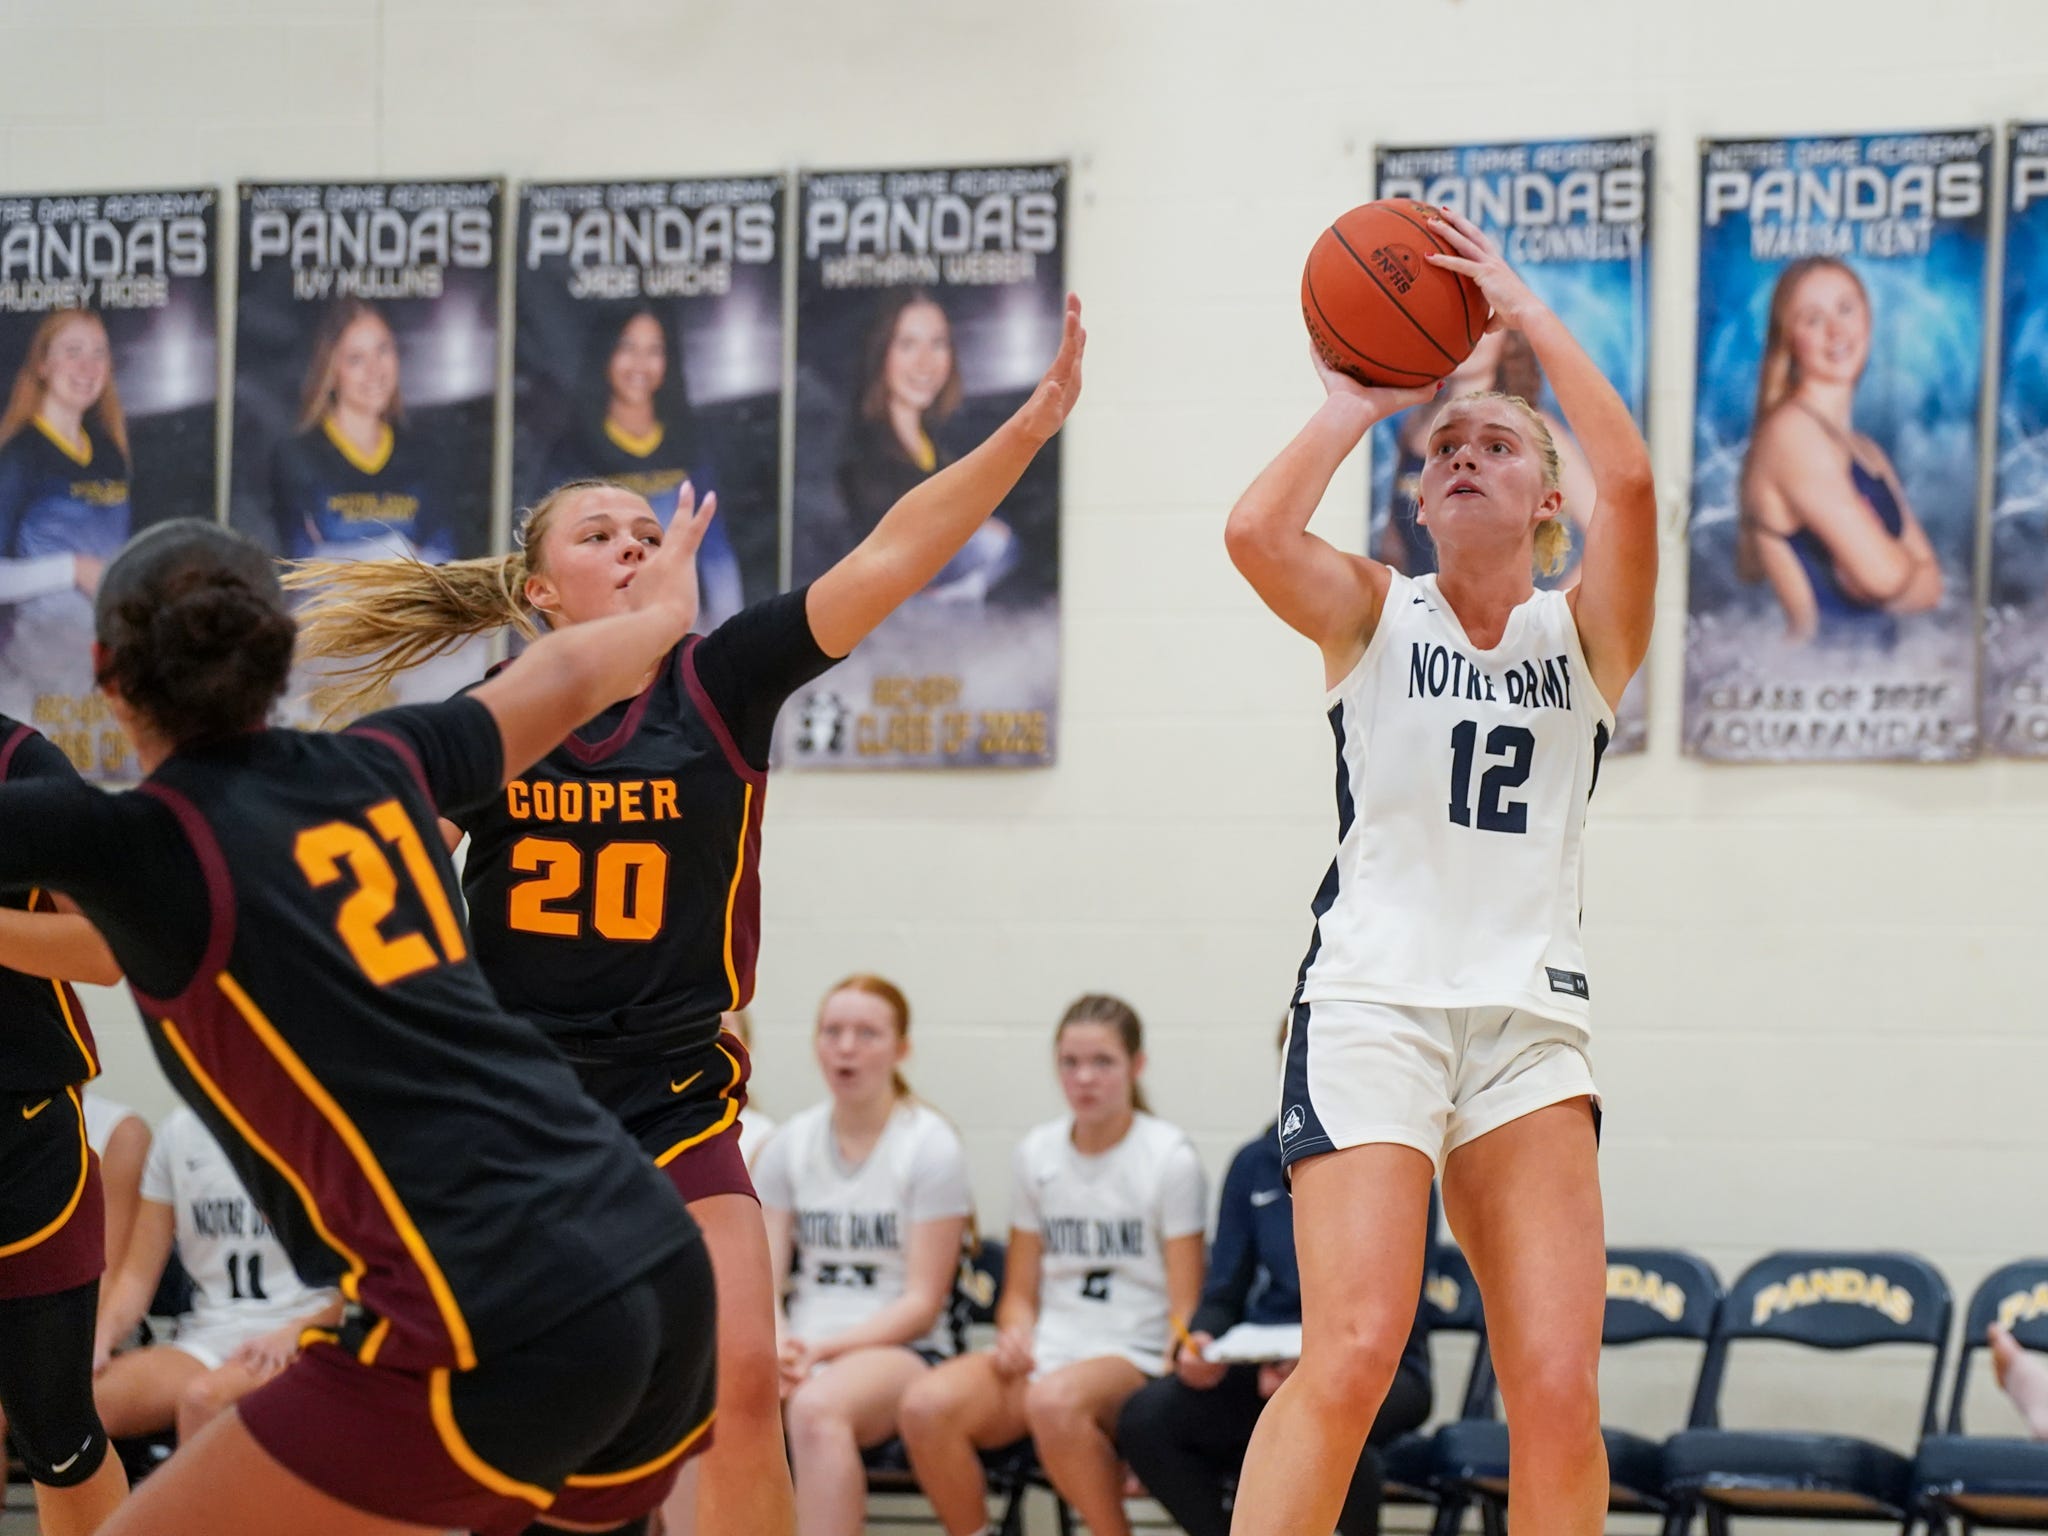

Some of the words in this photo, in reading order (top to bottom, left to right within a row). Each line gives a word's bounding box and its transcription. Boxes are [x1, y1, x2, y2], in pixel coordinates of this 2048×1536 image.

[1705, 161, 1984, 226] PANDAS
[0, 218, 207, 281] ANDAS
[250, 209, 492, 270] PANDAS
[527, 206, 775, 270] PANDAS
[805, 195, 1057, 259] PANDAS
[1510, 221, 1644, 263] CONNELLY
[293, 266, 334, 300] IVY
[1378, 257, 1411, 295] NFHS
[1408, 642, 1497, 702] NOTRE
[1704, 683, 1805, 712] CLASS
[1817, 683, 1859, 710] OF
[1695, 712, 1960, 748] AQUAPANDAS
[507, 777, 683, 824] COOPER
[1449, 719, 1536, 835] 12
[292, 796, 468, 988] 21
[507, 834, 671, 942] 20
[226, 1252, 269, 1300] 11
[1751, 1266, 1914, 1327] PANDAS
